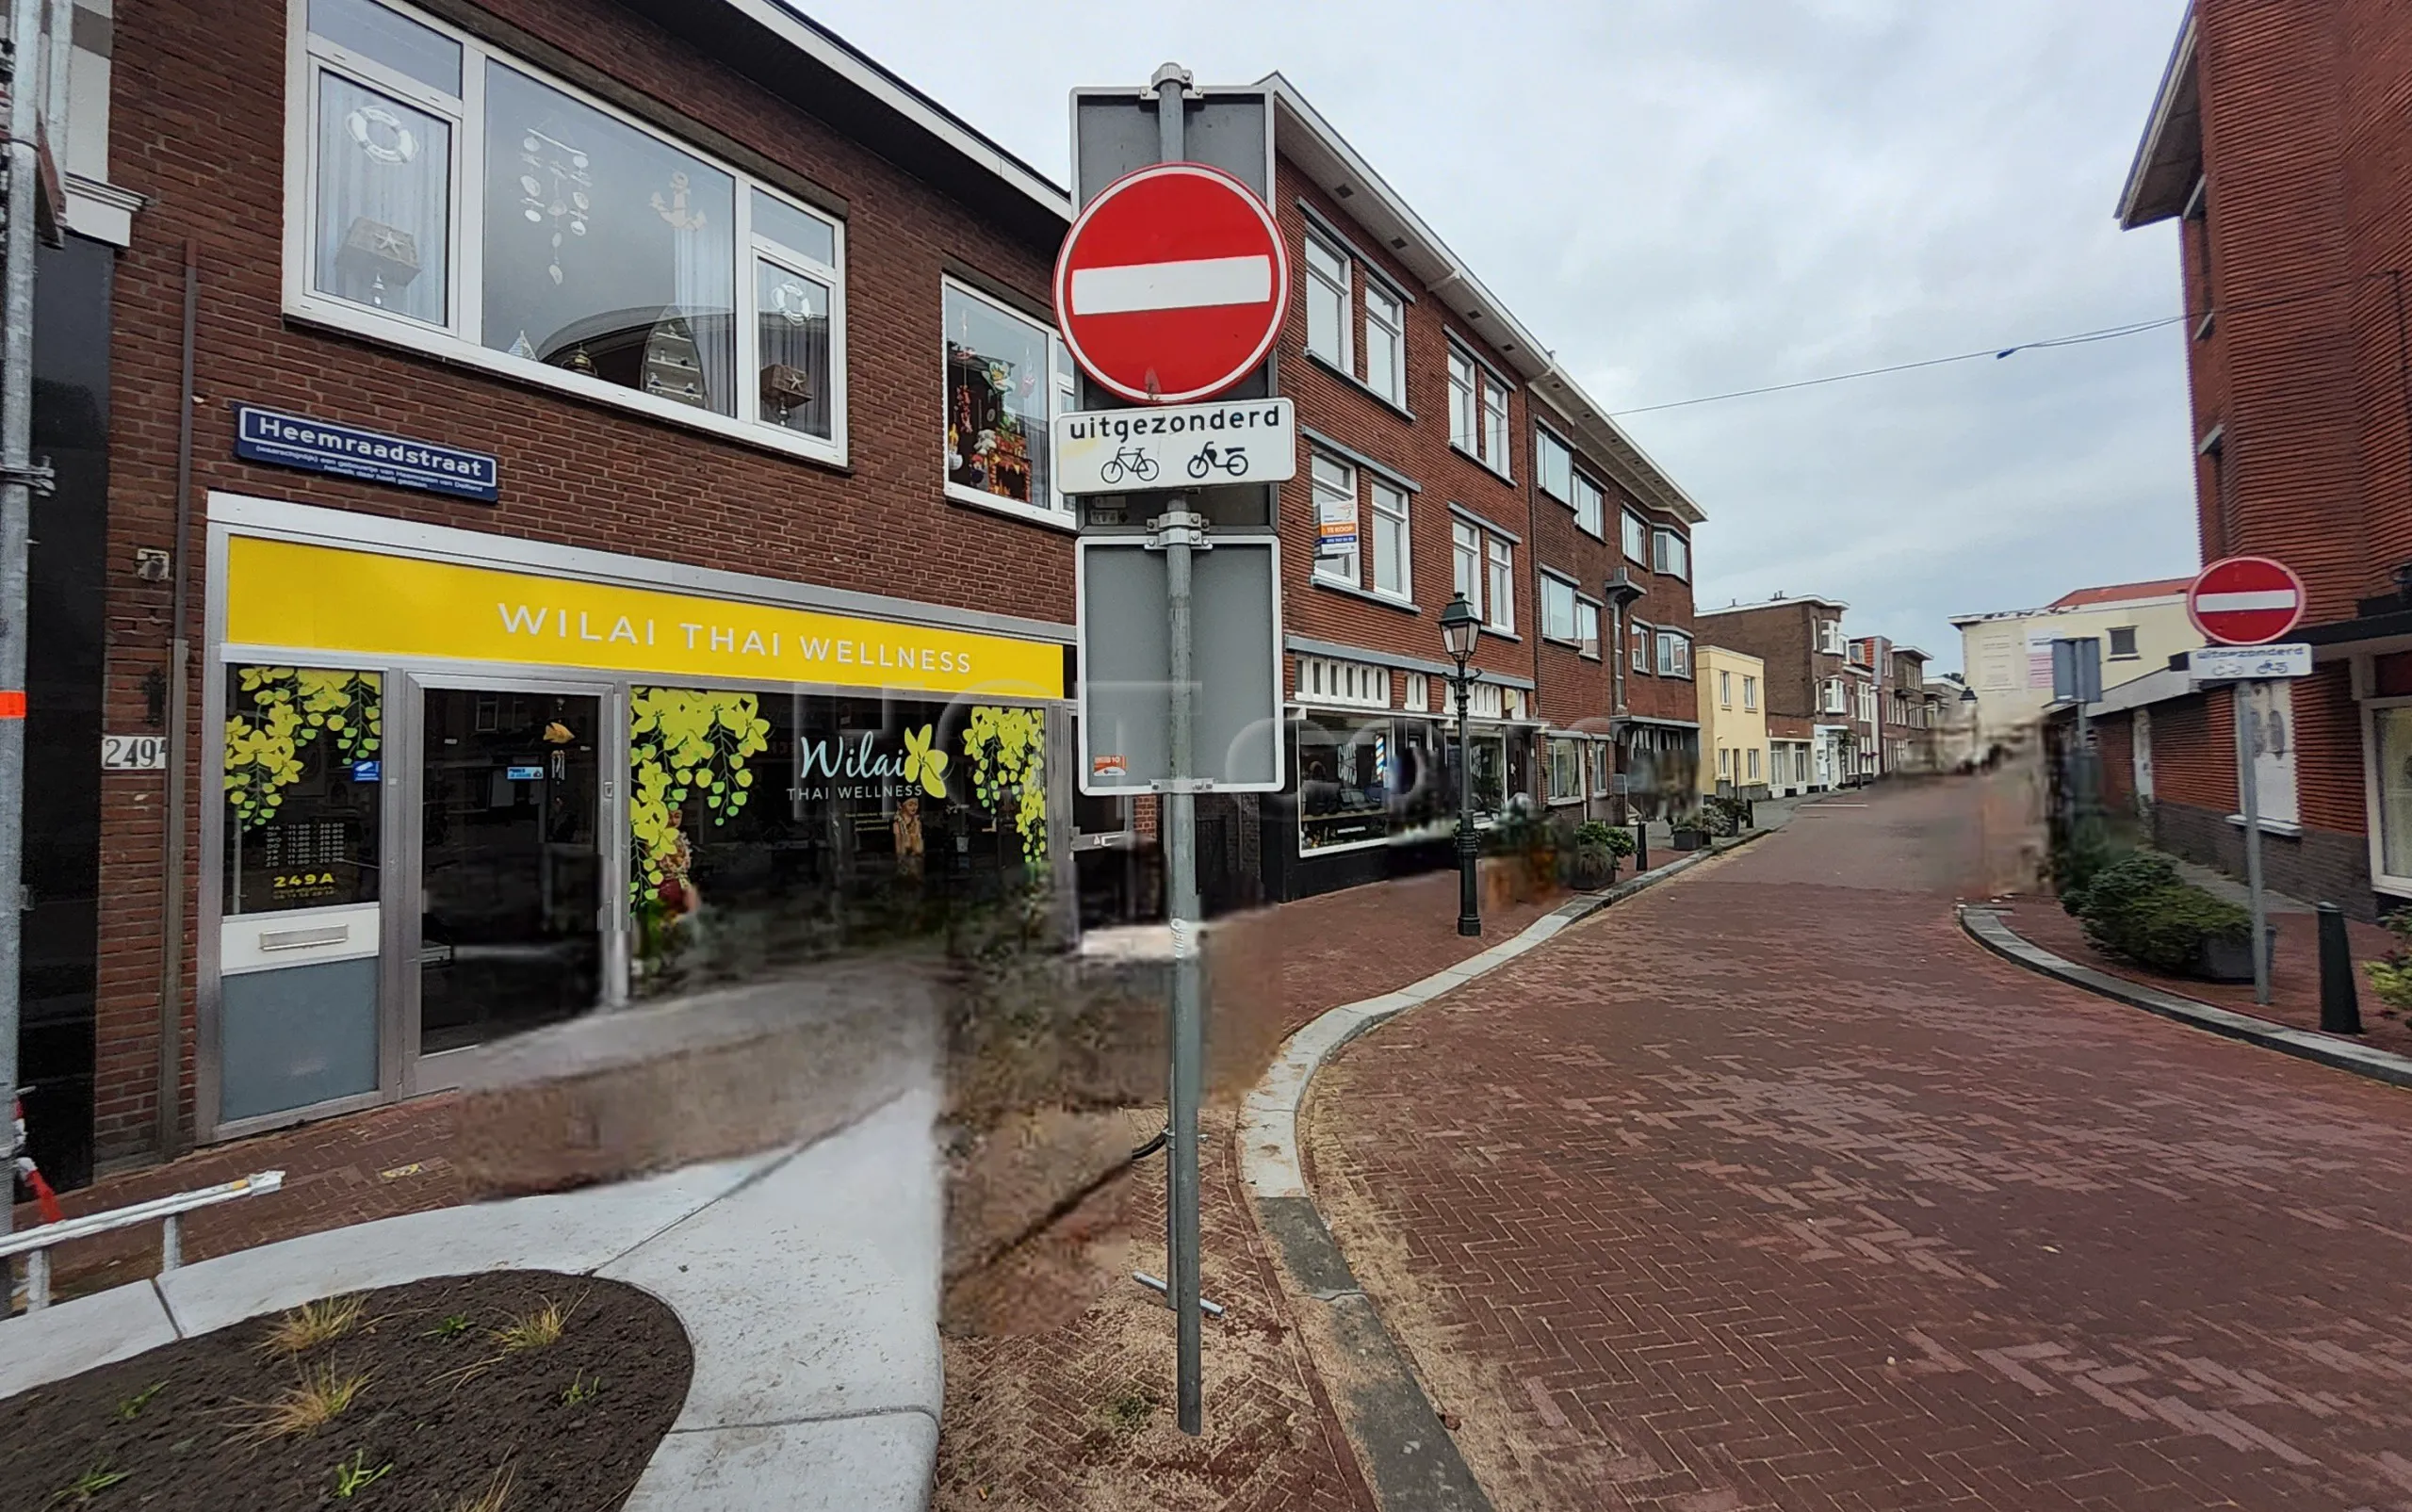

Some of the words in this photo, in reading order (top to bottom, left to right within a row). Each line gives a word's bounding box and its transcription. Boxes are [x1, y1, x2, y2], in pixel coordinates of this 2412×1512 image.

[1069, 405, 1279, 443] uitgezonderd
[259, 416, 481, 477] Heemraadstraat
[497, 602, 656, 646] WILAI
[679, 623, 779, 657] THAI
[799, 636, 971, 674] WELLNESS
[800, 730, 905, 779] Wilai
[786, 788, 829, 802] THAI
[838, 785, 922, 799] WELLNESS
[273, 872, 335, 887] 249A
